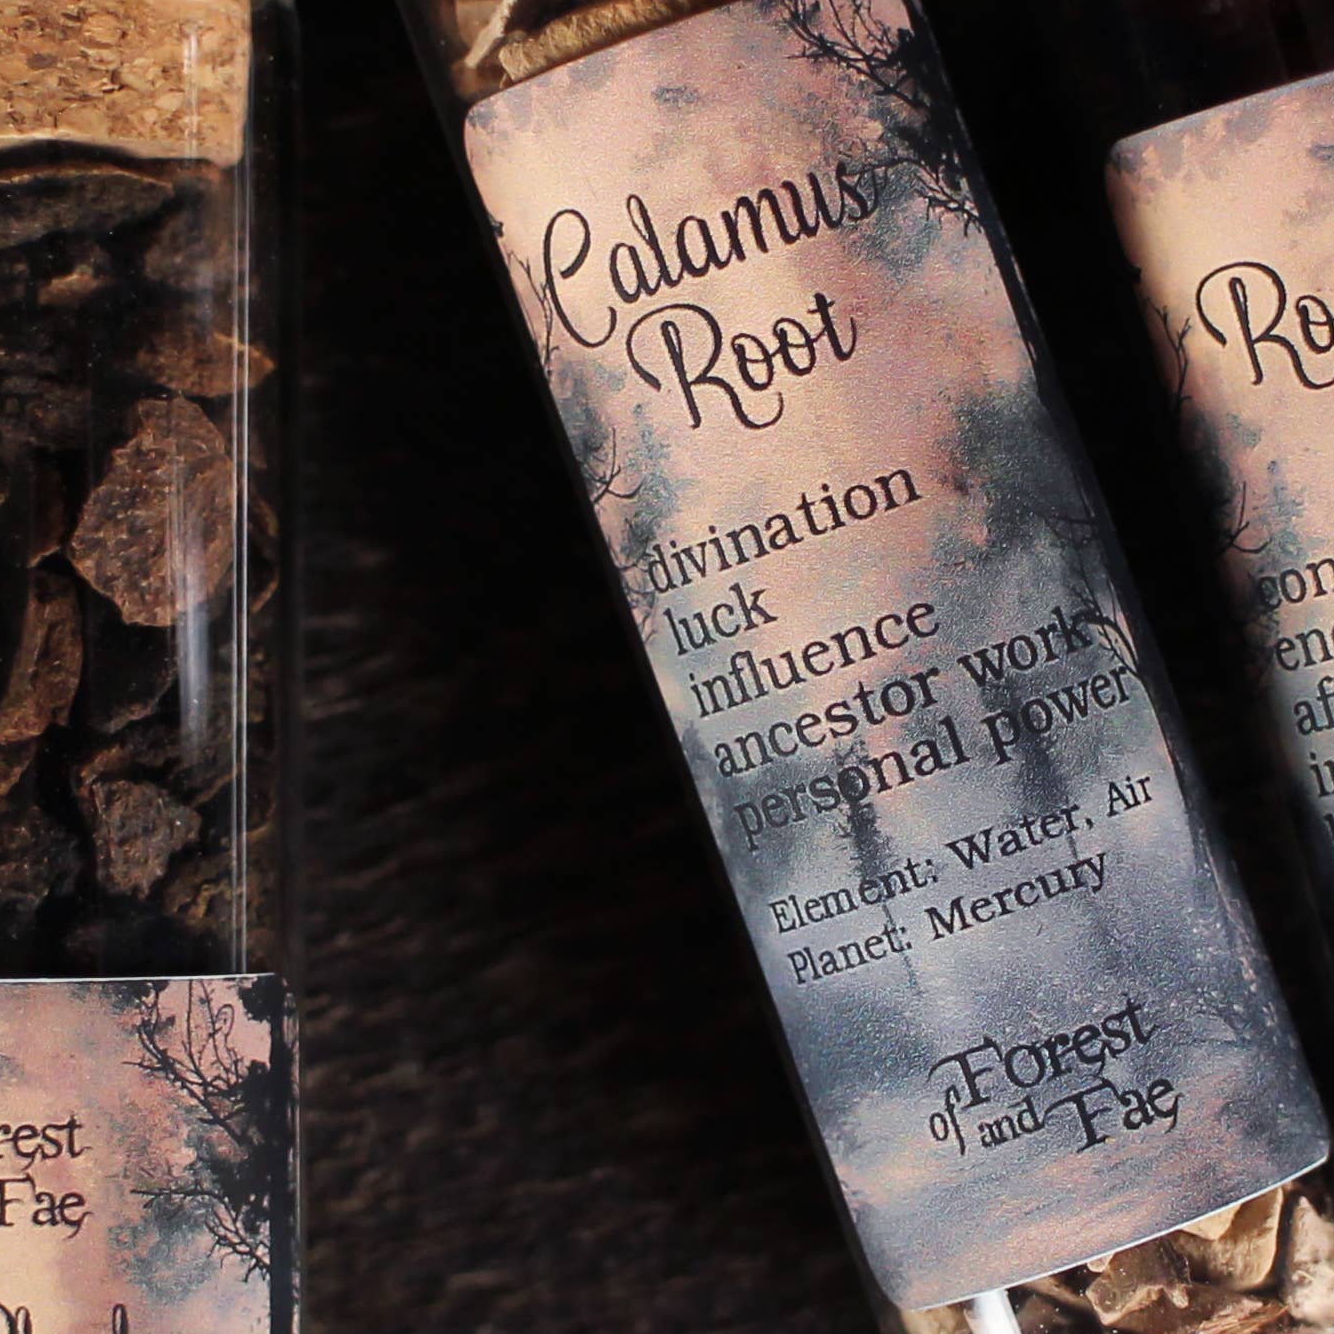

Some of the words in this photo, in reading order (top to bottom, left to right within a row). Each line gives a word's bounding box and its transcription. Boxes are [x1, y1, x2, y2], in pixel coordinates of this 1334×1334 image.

[542, 161, 881, 348] Calamus
[626, 292, 858, 429] Root
[647, 467, 921, 594] divination
[663, 583, 779, 656] luck
[688, 600, 940, 718] influence
[714, 663, 942, 777] ancestor
[958, 606, 1096, 688] work
[734, 715, 971, 851] personal
[982, 667, 1134, 764] power
[769, 856, 939, 934] Element:
[946, 804, 1094, 871] Water,
[1105, 772, 1152, 819] Air
[788, 923, 913, 985] Planet:
[924, 852, 1108, 942] Mercury
[927, 992, 1160, 1110] Forest
[978, 1096, 1044, 1149] and
[1042, 1075, 1186, 1153] Fae
[928, 1085, 965, 1156] of
